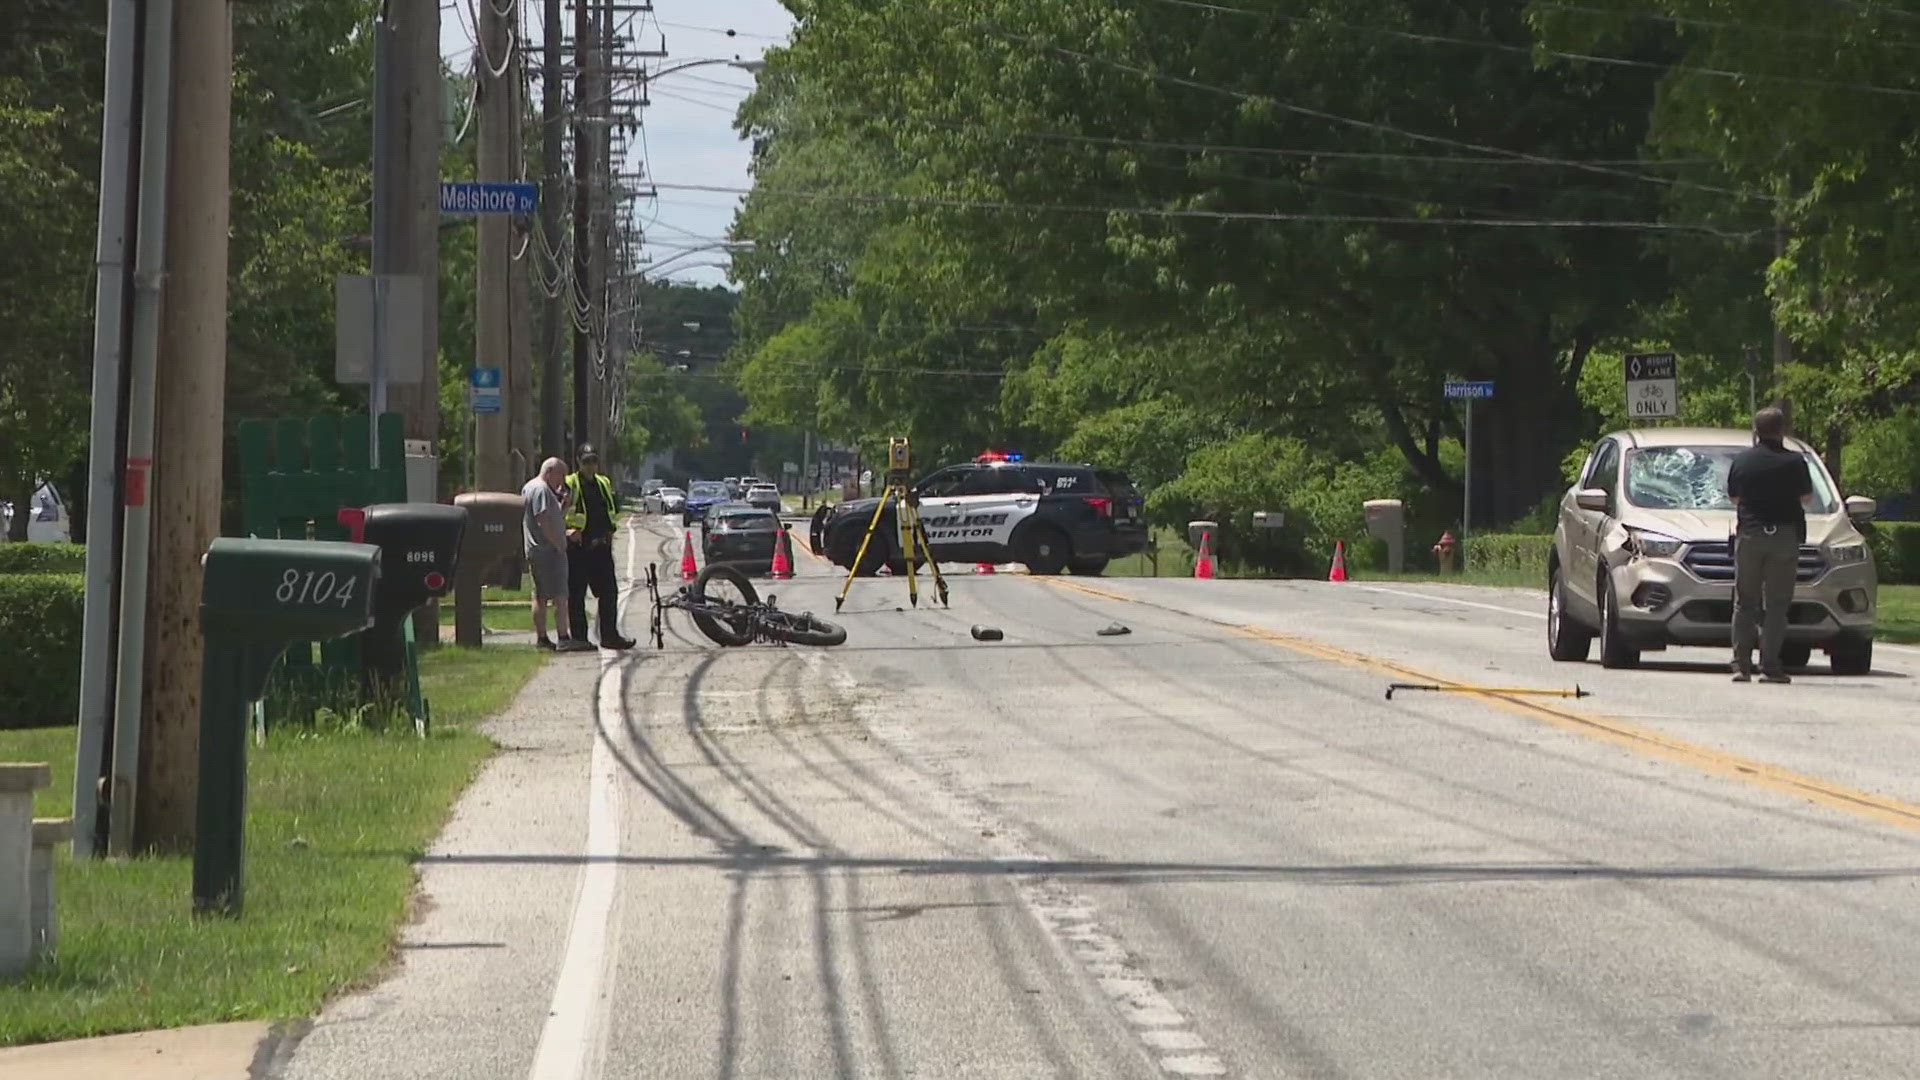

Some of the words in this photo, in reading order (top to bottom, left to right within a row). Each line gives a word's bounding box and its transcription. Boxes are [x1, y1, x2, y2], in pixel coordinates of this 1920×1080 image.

[442, 185, 516, 210] Melshore
[520, 196, 534, 210] Dr
[1648, 366, 1671, 377] LANE
[1444, 383, 1484, 398] Harrison
[1636, 400, 1668, 414] ONLY
[926, 528, 994, 539] MENTOR
[406, 551, 435, 562] 8096
[276, 568, 357, 609] 8104
